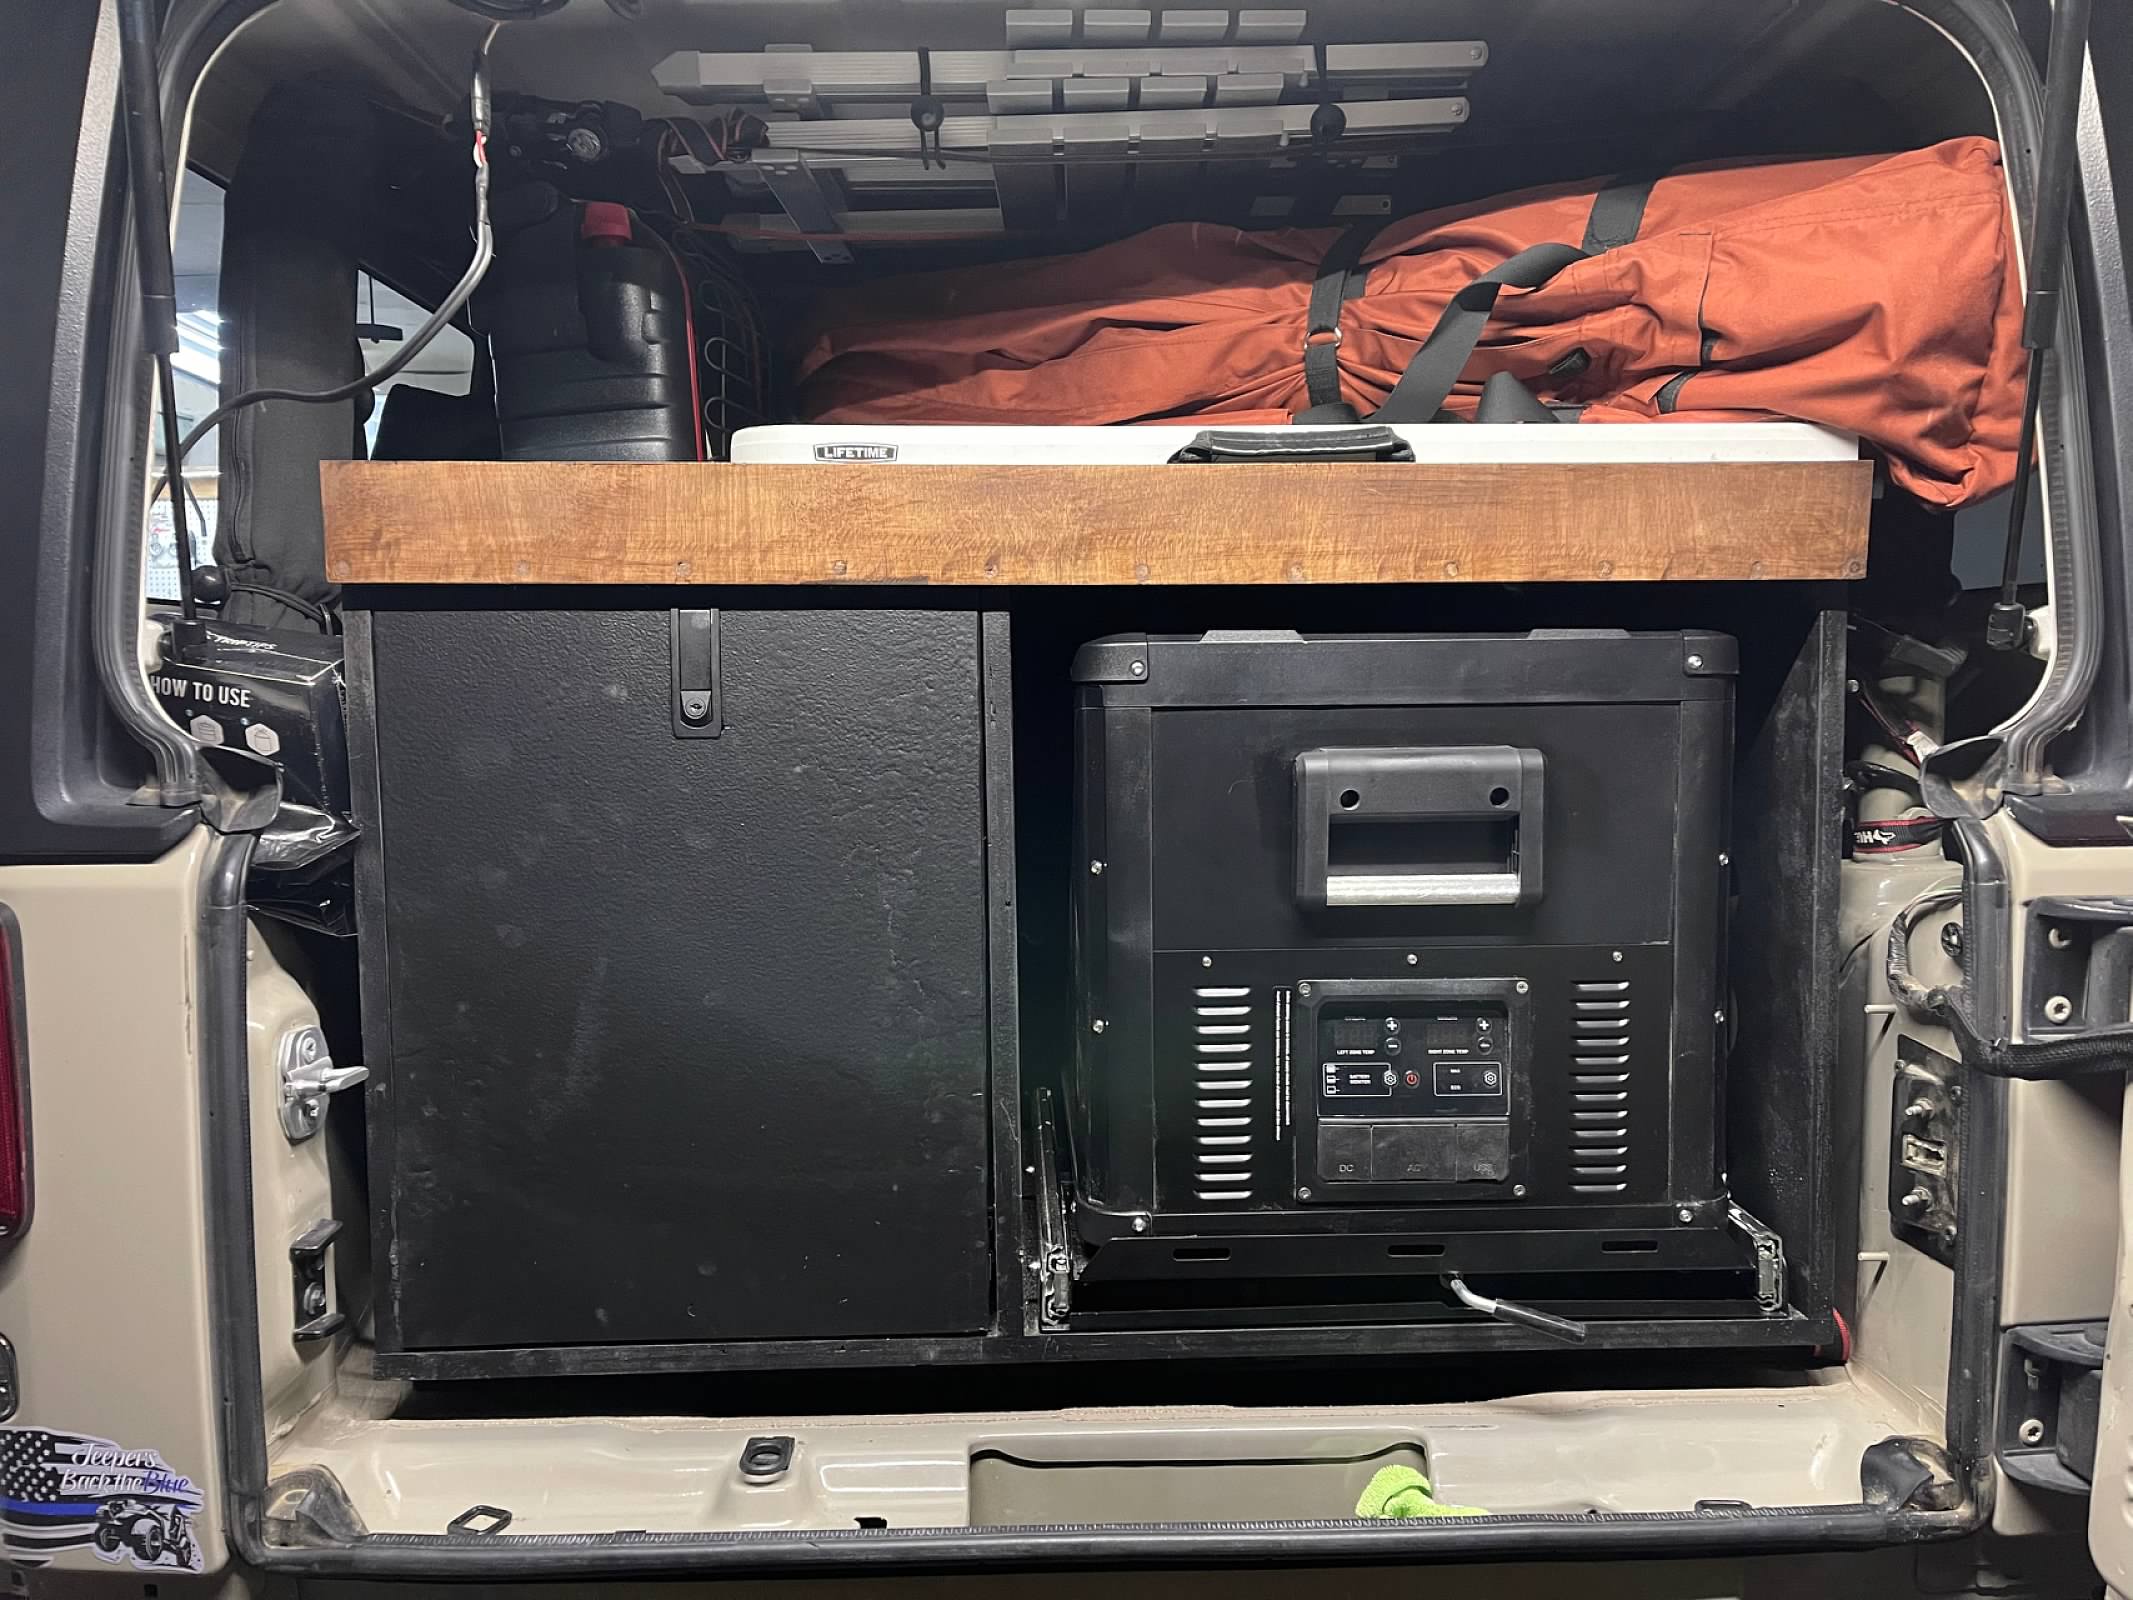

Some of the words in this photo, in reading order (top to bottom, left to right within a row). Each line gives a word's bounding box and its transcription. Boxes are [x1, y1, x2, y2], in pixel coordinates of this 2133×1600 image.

[824, 447, 888, 459] LIFETIME
[151, 675, 187, 698] HOW
[192, 682, 213, 702] TO
[218, 685, 251, 708] USE
[1338, 1164, 1354, 1173] DC
[71, 1443, 157, 1472] Jeepers
[60, 1468, 113, 1491] Back
[113, 1471, 144, 1492] the
[142, 1470, 190, 1493] Blue
